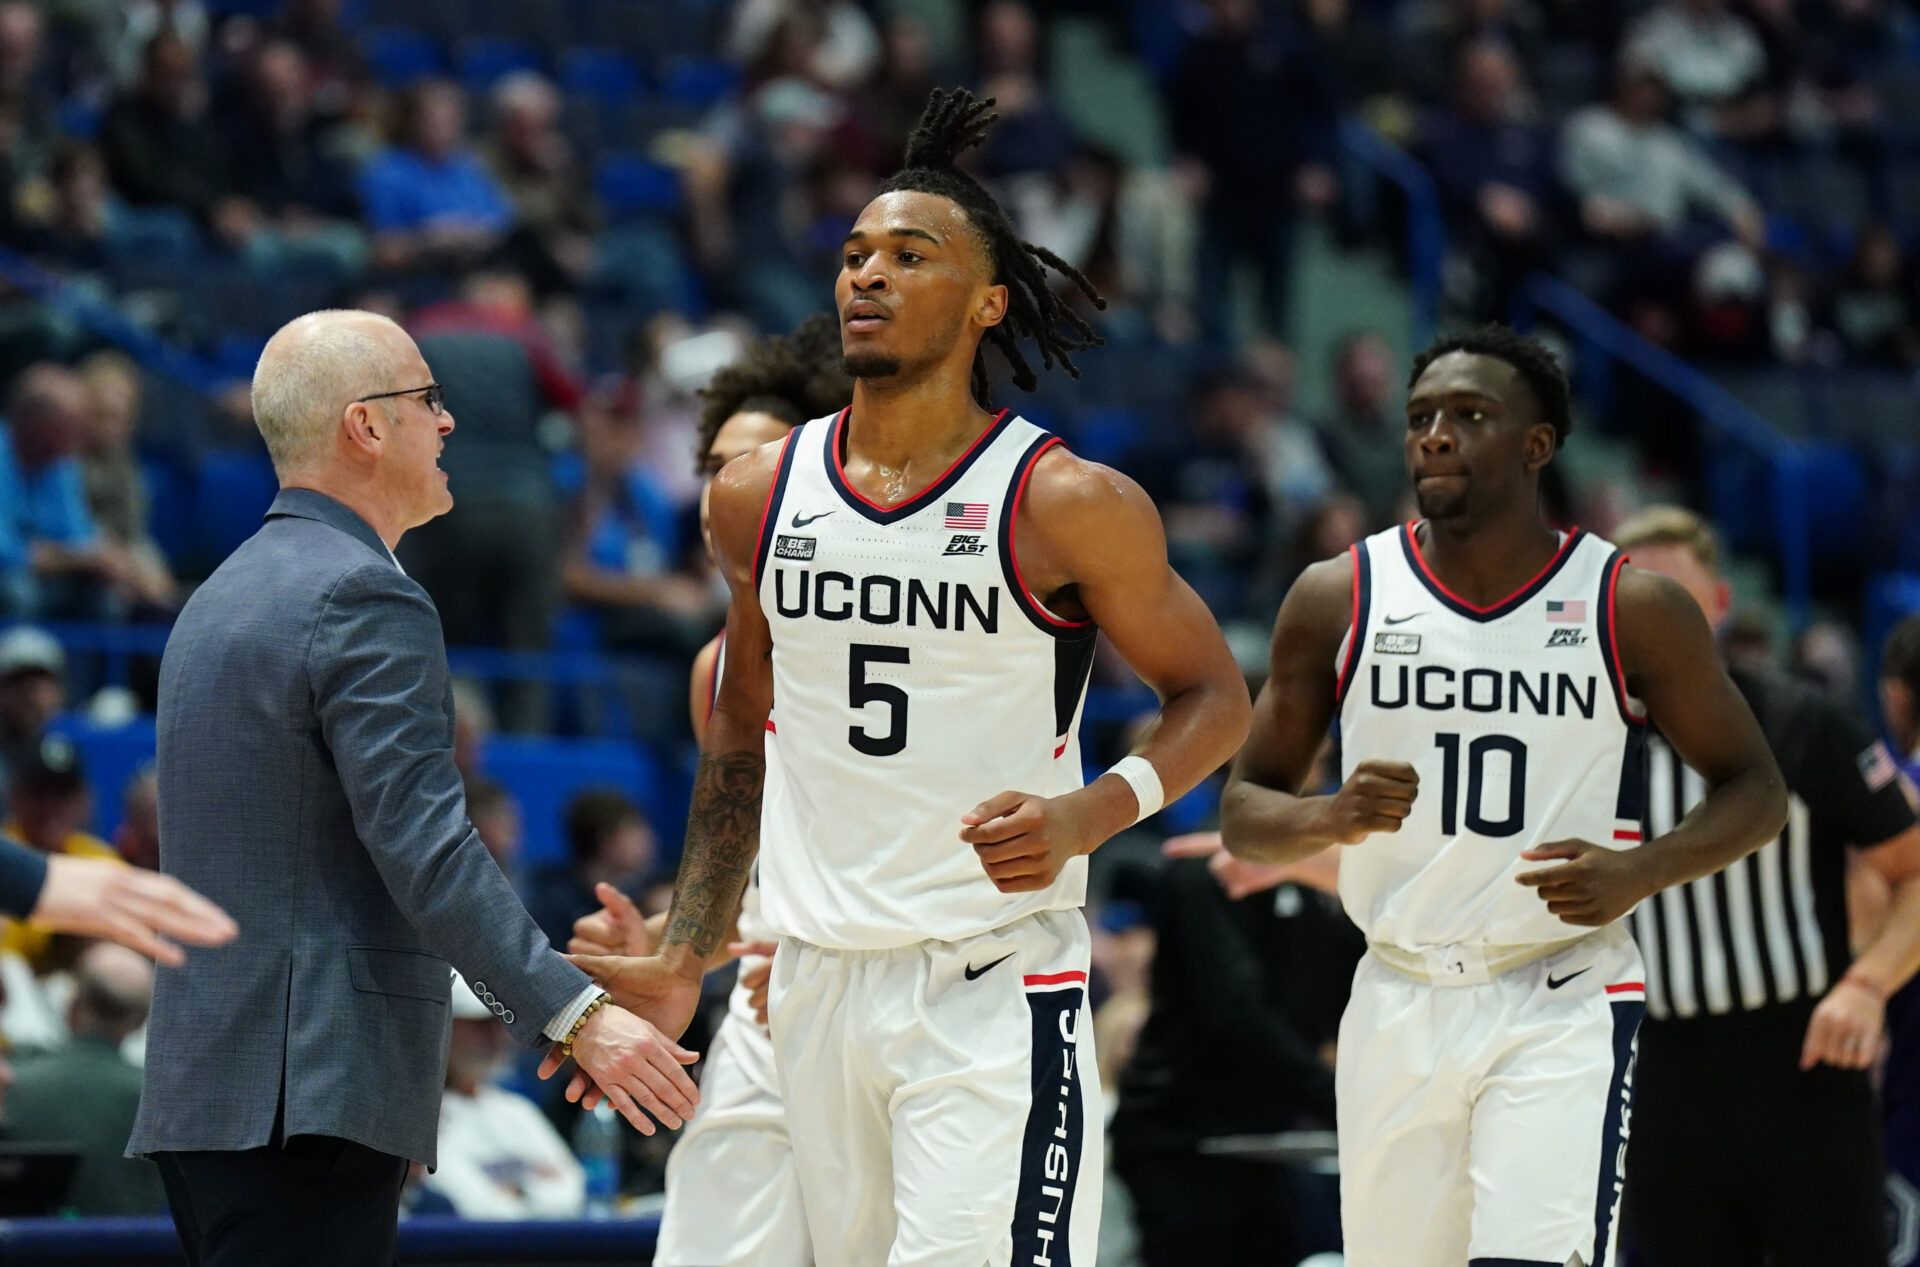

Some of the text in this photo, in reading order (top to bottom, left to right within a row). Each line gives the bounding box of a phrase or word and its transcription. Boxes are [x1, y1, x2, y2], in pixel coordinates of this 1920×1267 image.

[787, 539, 806, 549] BE
[945, 543, 988, 553] EAST
[950, 535, 981, 544] BIG
[775, 569, 999, 634] UCONN
[1548, 635, 1588, 645] EAST
[848, 643, 910, 757] 5
[1371, 665, 1597, 720] UCONN
[1434, 732, 1528, 838] 10
